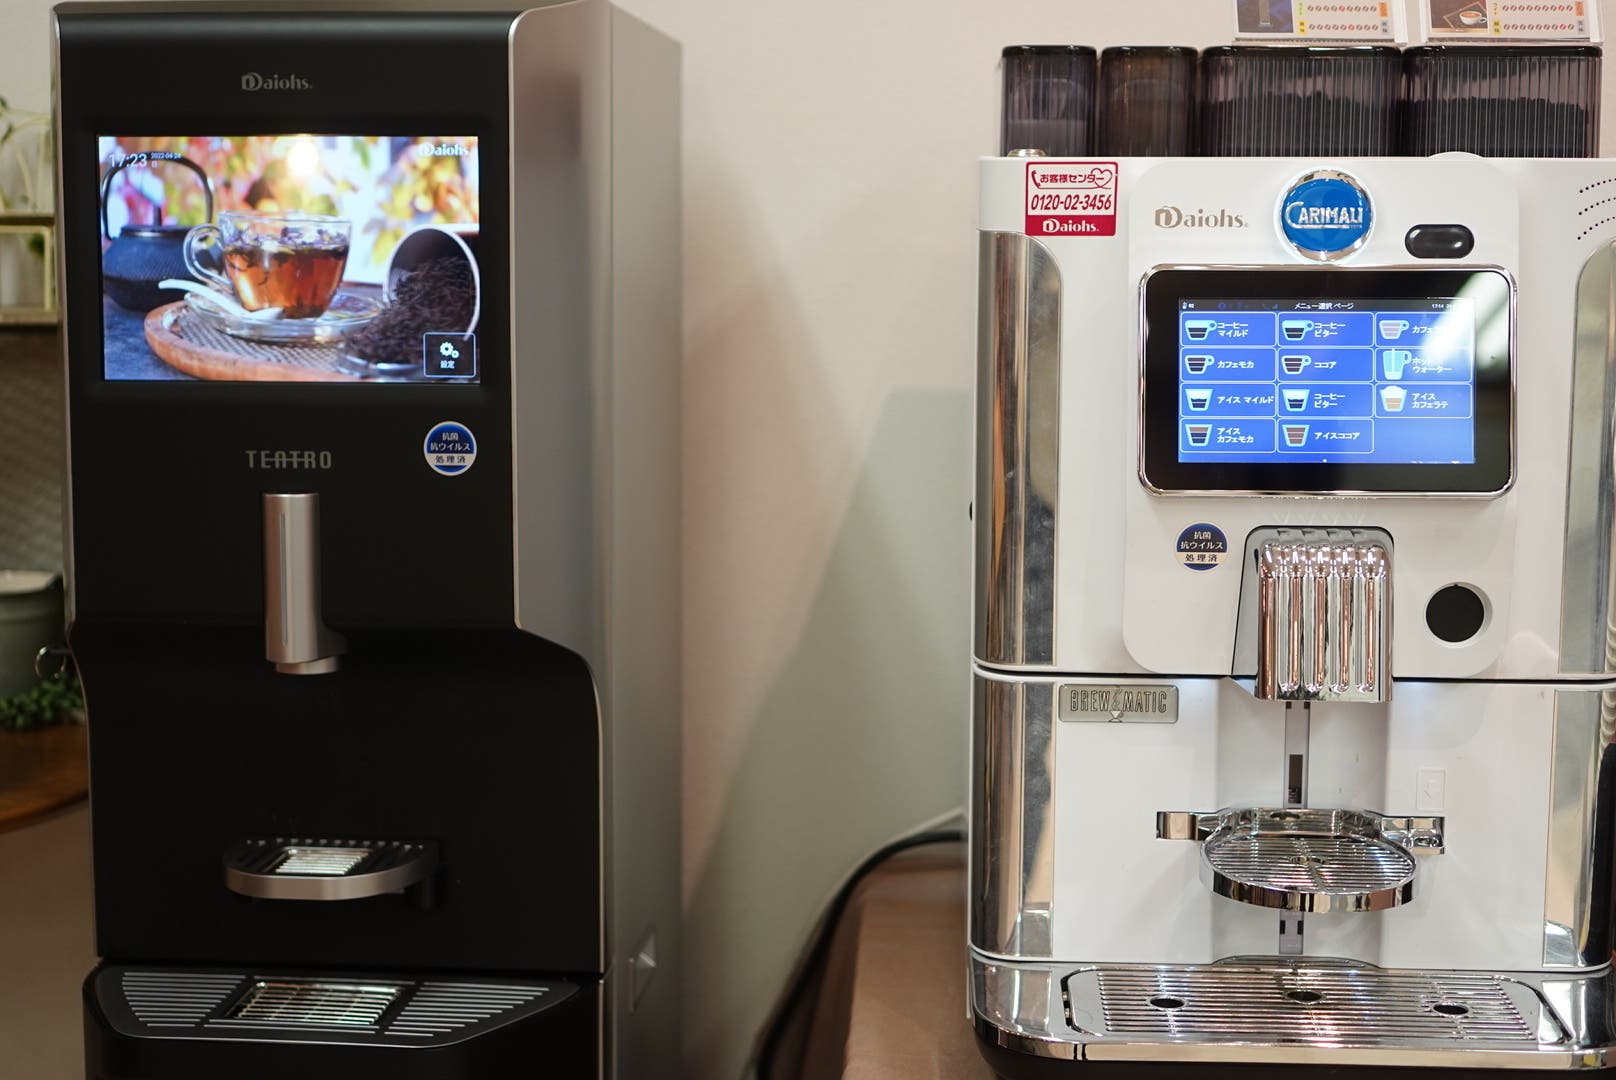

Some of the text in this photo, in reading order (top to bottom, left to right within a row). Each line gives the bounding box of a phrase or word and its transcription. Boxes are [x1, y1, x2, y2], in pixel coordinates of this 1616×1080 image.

[241, 71, 310, 92] Daiohs
[109, 152, 148, 168] 17:23
[1040, 174, 1105, 184] お客様センター
[1031, 194, 1112, 210] 0120-02-3456
[1154, 205, 1245, 229] Daiohs
[1285, 201, 1364, 230] CARIMALI
[1042, 218, 1098, 233] Daiohs
[1217, 329, 1249, 338] マイルド
[1217, 361, 1255, 369] カフェモカ
[1314, 361, 1337, 369] ココア
[1216, 396, 1275, 404] アイス マイルド
[1412, 392, 1436, 400] アイス
[1411, 401, 1448, 409] カフェラテ
[1216, 427, 1241, 435] アイス
[1216, 435, 1254, 443] カフェモカ
[1314, 432, 1360, 440] アイスココア
[430, 441, 471, 451] 抗ウイルス
[245, 450, 333, 469] TEATRO
[1180, 541, 1224, 550] 抗ウイルス
